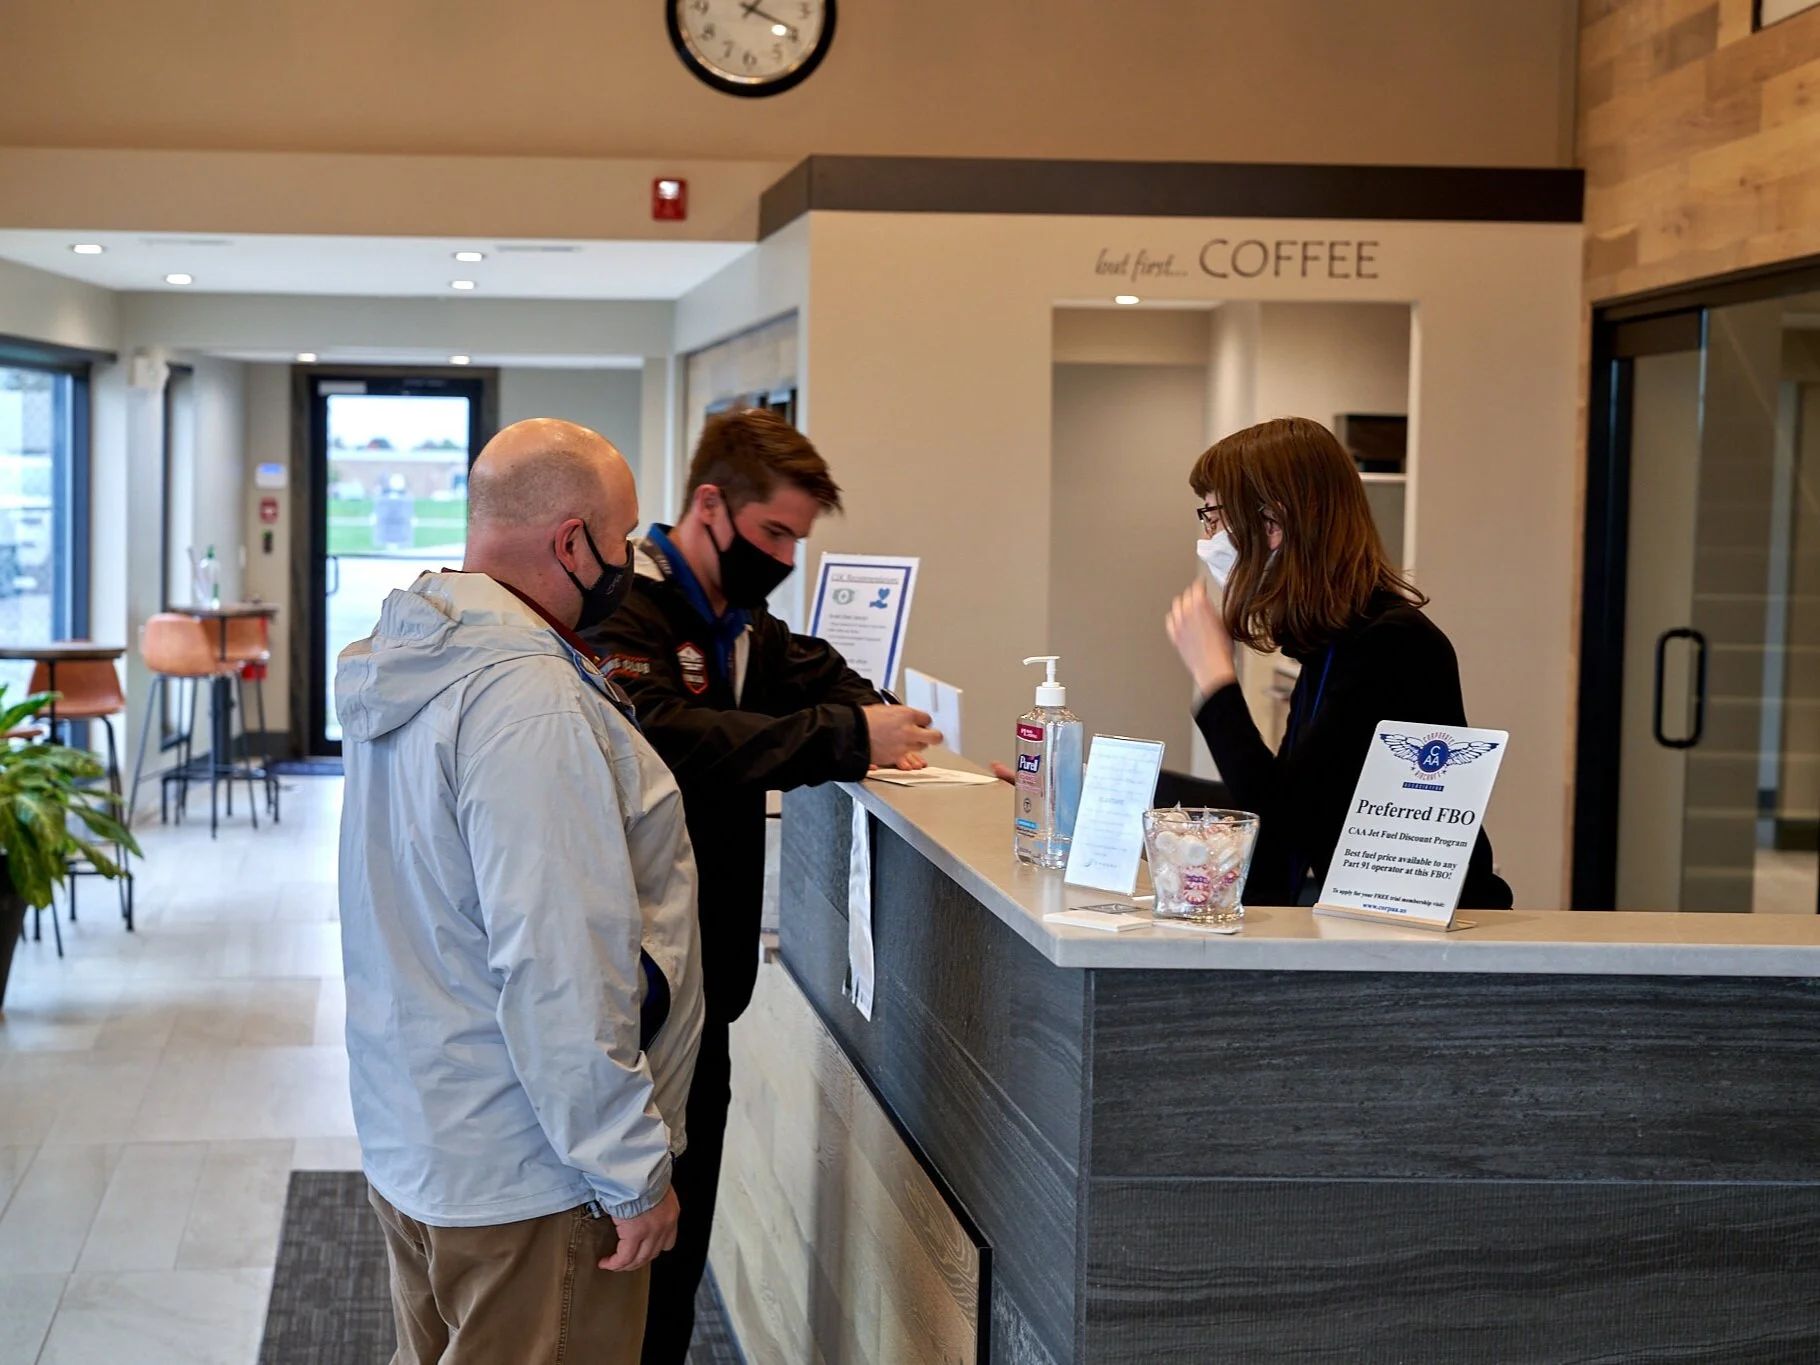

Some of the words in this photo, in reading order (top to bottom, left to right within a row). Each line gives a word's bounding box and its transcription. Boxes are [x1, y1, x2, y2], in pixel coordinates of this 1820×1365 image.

[1095, 248, 1130, 275] but
[1199, 238, 1380, 279] COFFEE
[1356, 798, 1433, 821] Preferred
[1436, 807, 1476, 825] FBO
[1348, 826, 1366, 836] CAA
[1367, 829, 1380, 838] Jet
[1380, 830, 1398, 840] Fuel
[1399, 832, 1433, 844] Discount
[1433, 836, 1468, 847] Program
[1343, 859, 1360, 868] Part
[1360, 861, 1370, 870] 91
[1371, 864, 1404, 874] operator
[1405, 867, 1413, 875] at
[1414, 868, 1429, 877] this
[1430, 870, 1452, 880] FBO!
[1344, 848, 1361, 857] Best
[1361, 850, 1376, 860] fuel
[1376, 853, 1397, 863] price
[1398, 856, 1432, 866] available
[1433, 860, 1441, 868] to
[1442, 862, 1457, 871] any
